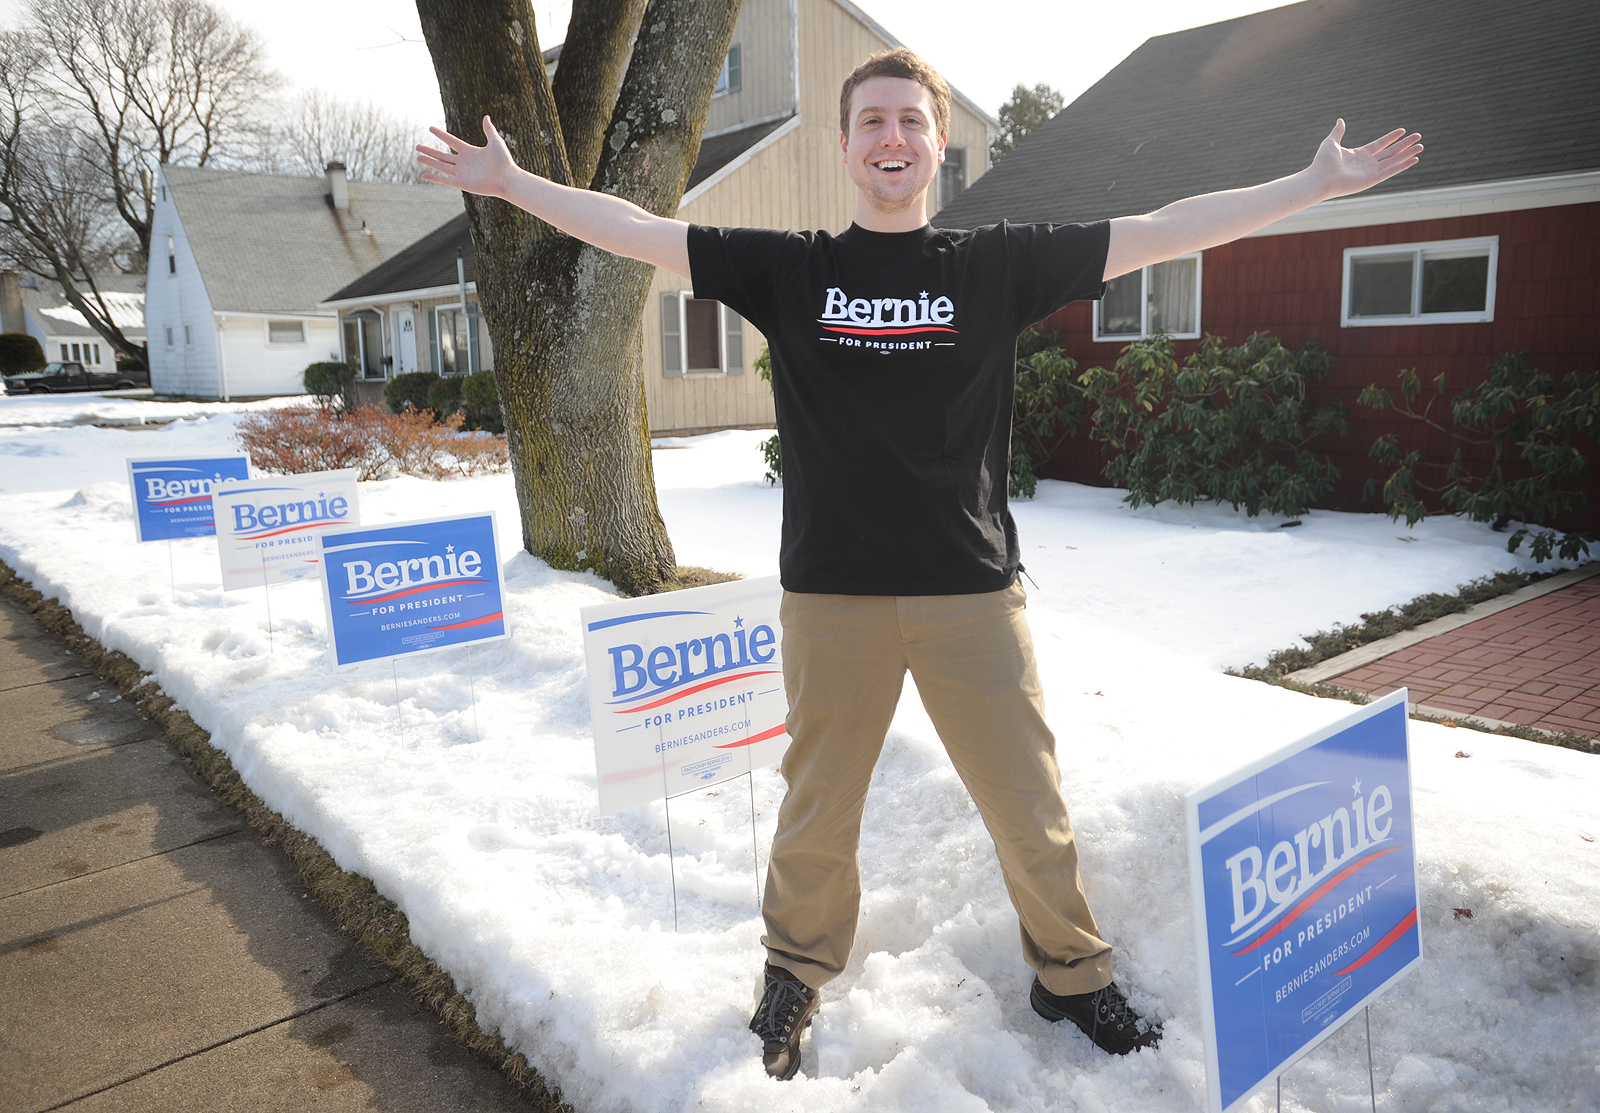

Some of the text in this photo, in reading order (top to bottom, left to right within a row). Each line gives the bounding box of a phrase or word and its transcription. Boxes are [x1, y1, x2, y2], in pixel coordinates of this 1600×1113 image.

[822, 287, 955, 324] Bernie
[839, 337, 932, 350] FOR PRESIDENT
[145, 472, 238, 499] Bern
[231, 491, 348, 531] Bernie
[255, 541, 275, 549] FOR
[343, 543, 482, 595] Bernie
[372, 594, 463, 616] FOR PRESIDENT
[381, 612, 461, 631] BERNIESANDERS.COM
[607, 615, 776, 698] Bernie
[644, 691, 755, 729] FOR PRESIDENT
[655, 718, 752, 754] BERNIESANDERS.COM
[1226, 777, 1393, 934] Bernie
[1264, 886, 1373, 971] FOR PRESIDENT
[1275, 926, 1371, 1003] BERNIESANDERS.COM
